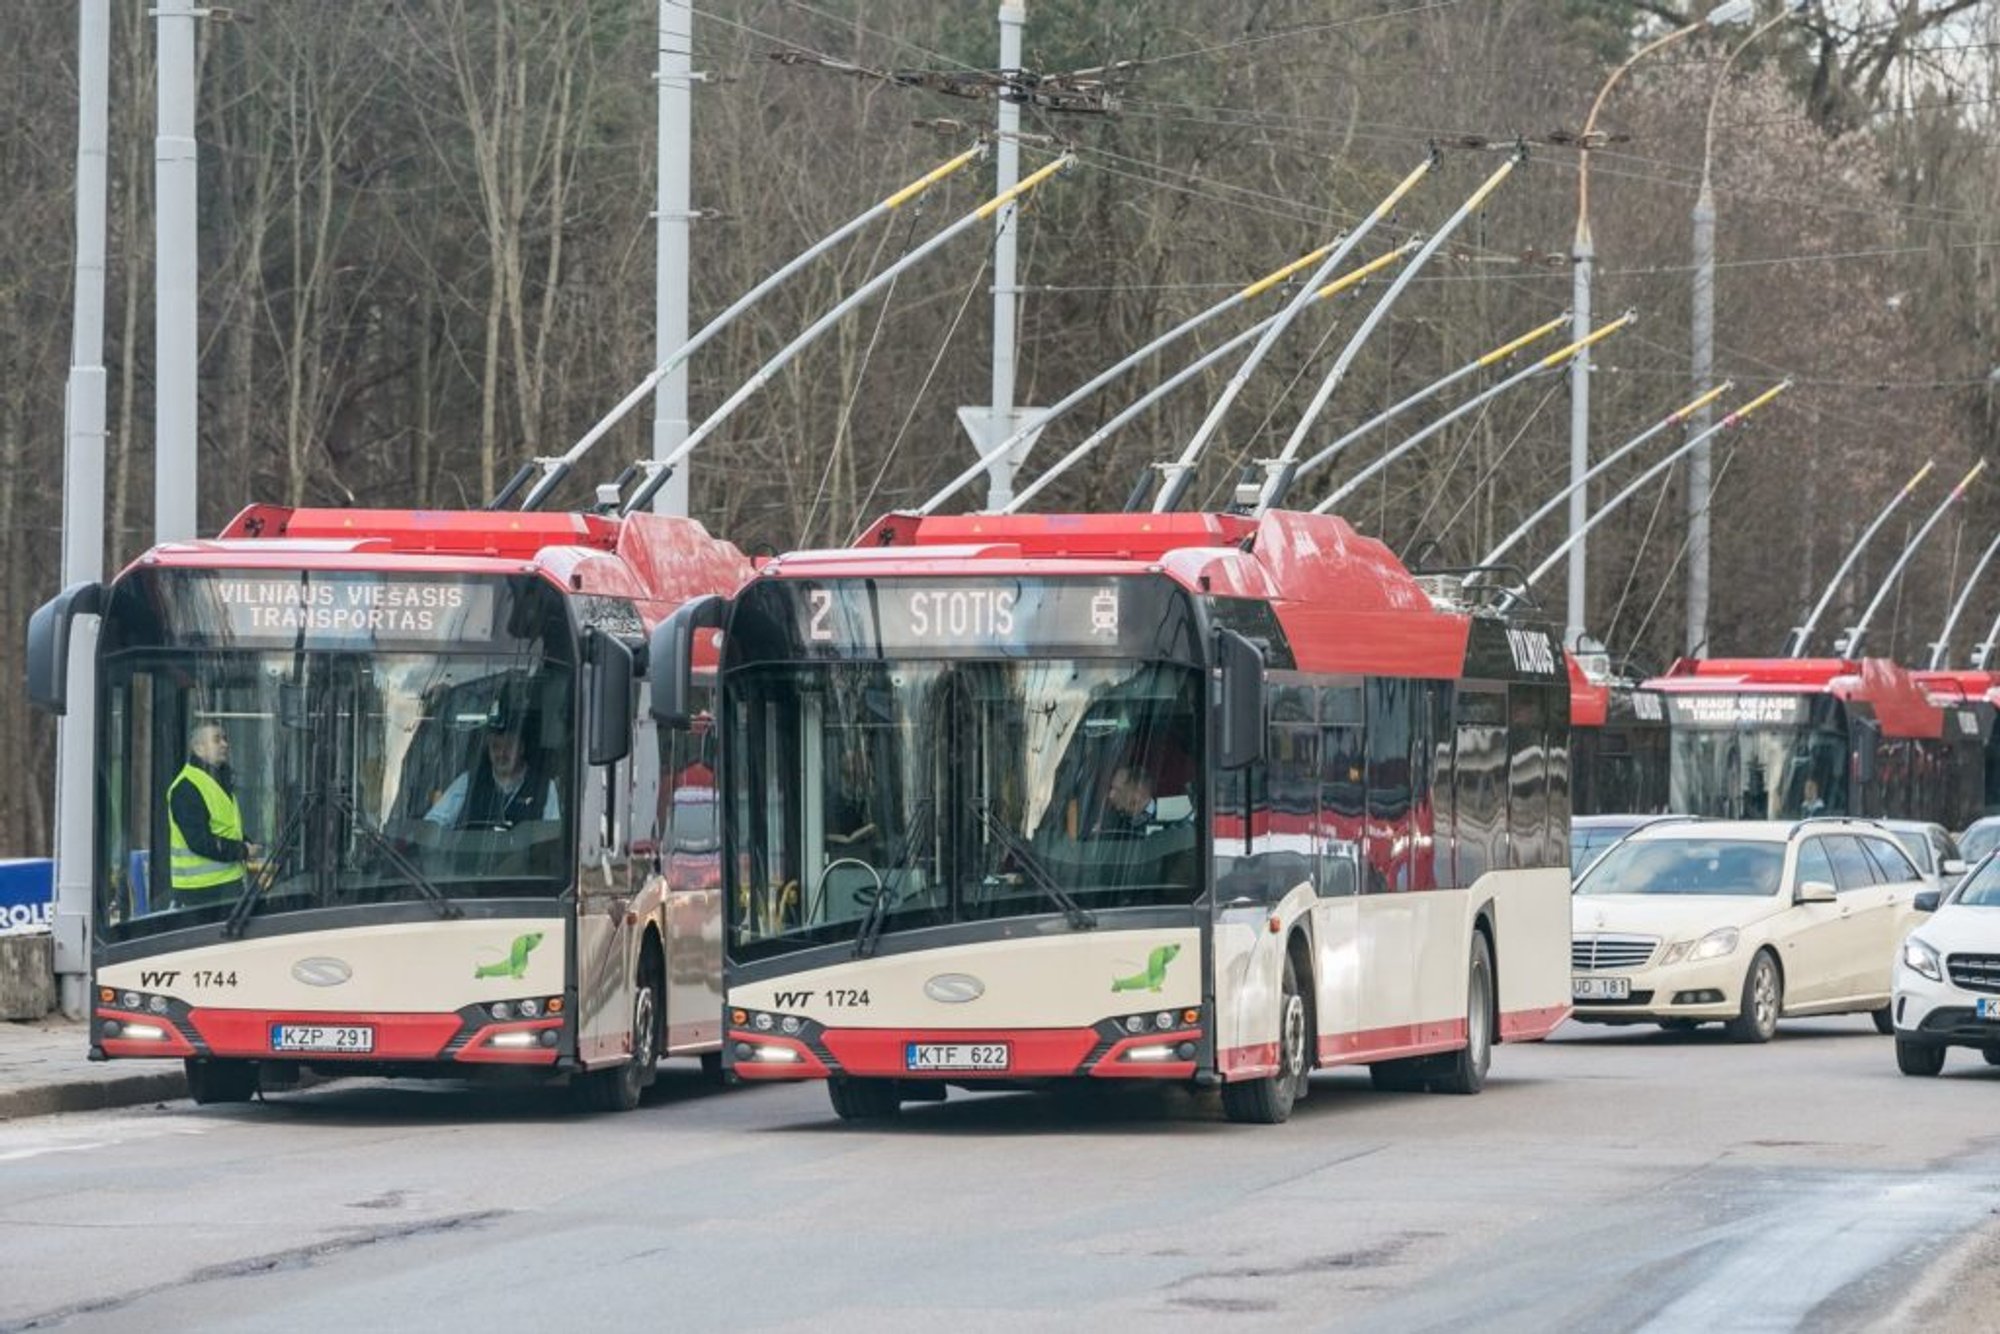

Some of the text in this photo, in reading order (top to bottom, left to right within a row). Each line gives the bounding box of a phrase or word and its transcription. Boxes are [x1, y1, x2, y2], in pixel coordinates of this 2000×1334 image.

[218, 583, 335, 605] VILNIAUS
[250, 607, 434, 630] TRANSPORTAS
[809, 589, 832, 640] 2
[909, 591, 1014, 636] STOTIS
[194, 971, 238, 987] 1744
[1603, 980, 1626, 994] 181
[826, 989, 870, 1008] 1724
[284, 1028, 324, 1045] KZP
[336, 1029, 370, 1046] 291
[918, 1046, 958, 1064] KTF
[970, 1046, 1005, 1065] 622
